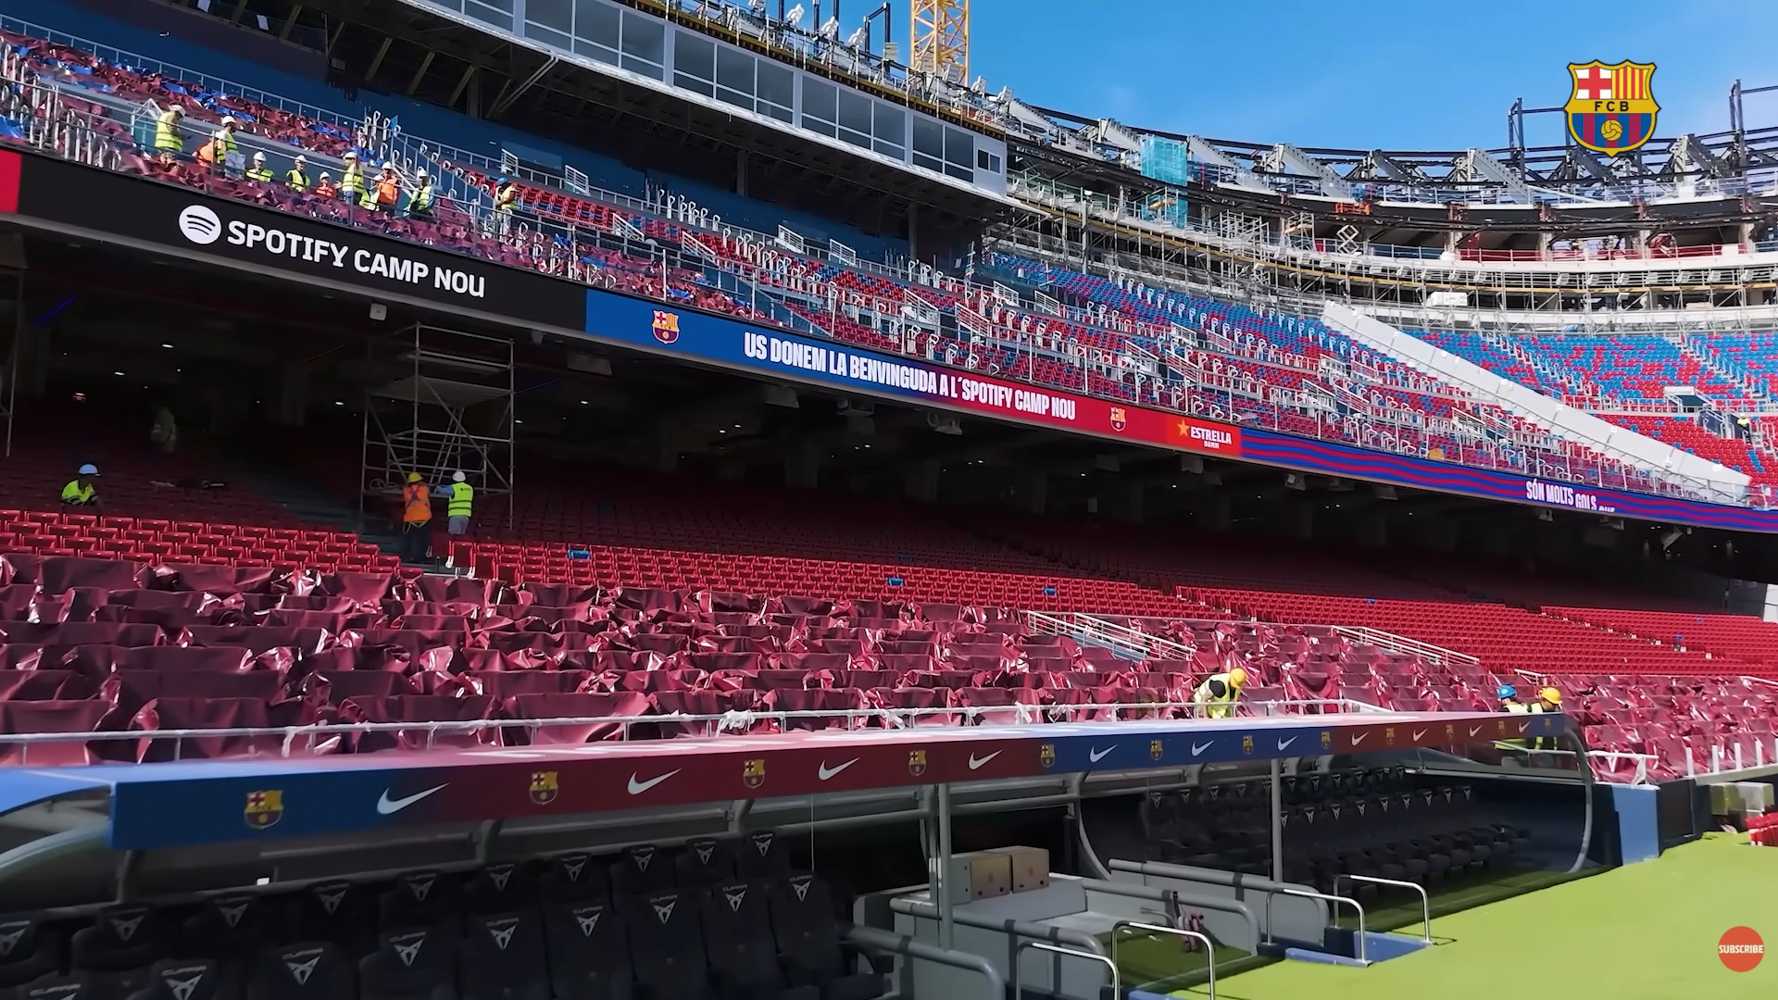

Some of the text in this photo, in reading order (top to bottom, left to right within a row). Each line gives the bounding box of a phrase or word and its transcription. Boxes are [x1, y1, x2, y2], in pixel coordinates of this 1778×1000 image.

[226, 220, 486, 298] SPOTIFY CAMP NOU
[744, 332, 768, 360] US
[770, 337, 827, 373] DONEM
[829, 350, 847, 377] LA
[850, 355, 938, 394] BENVINGUDA
[939, 374, 949, 397] A
[1014, 390, 1049, 415] CAMP
[1052, 397, 1076, 420] NOU
[1190, 425, 1232, 445] ESTRELLA
[1526, 478, 1545, 501] SÓN
[1546, 484, 1574, 505] MOLTS
